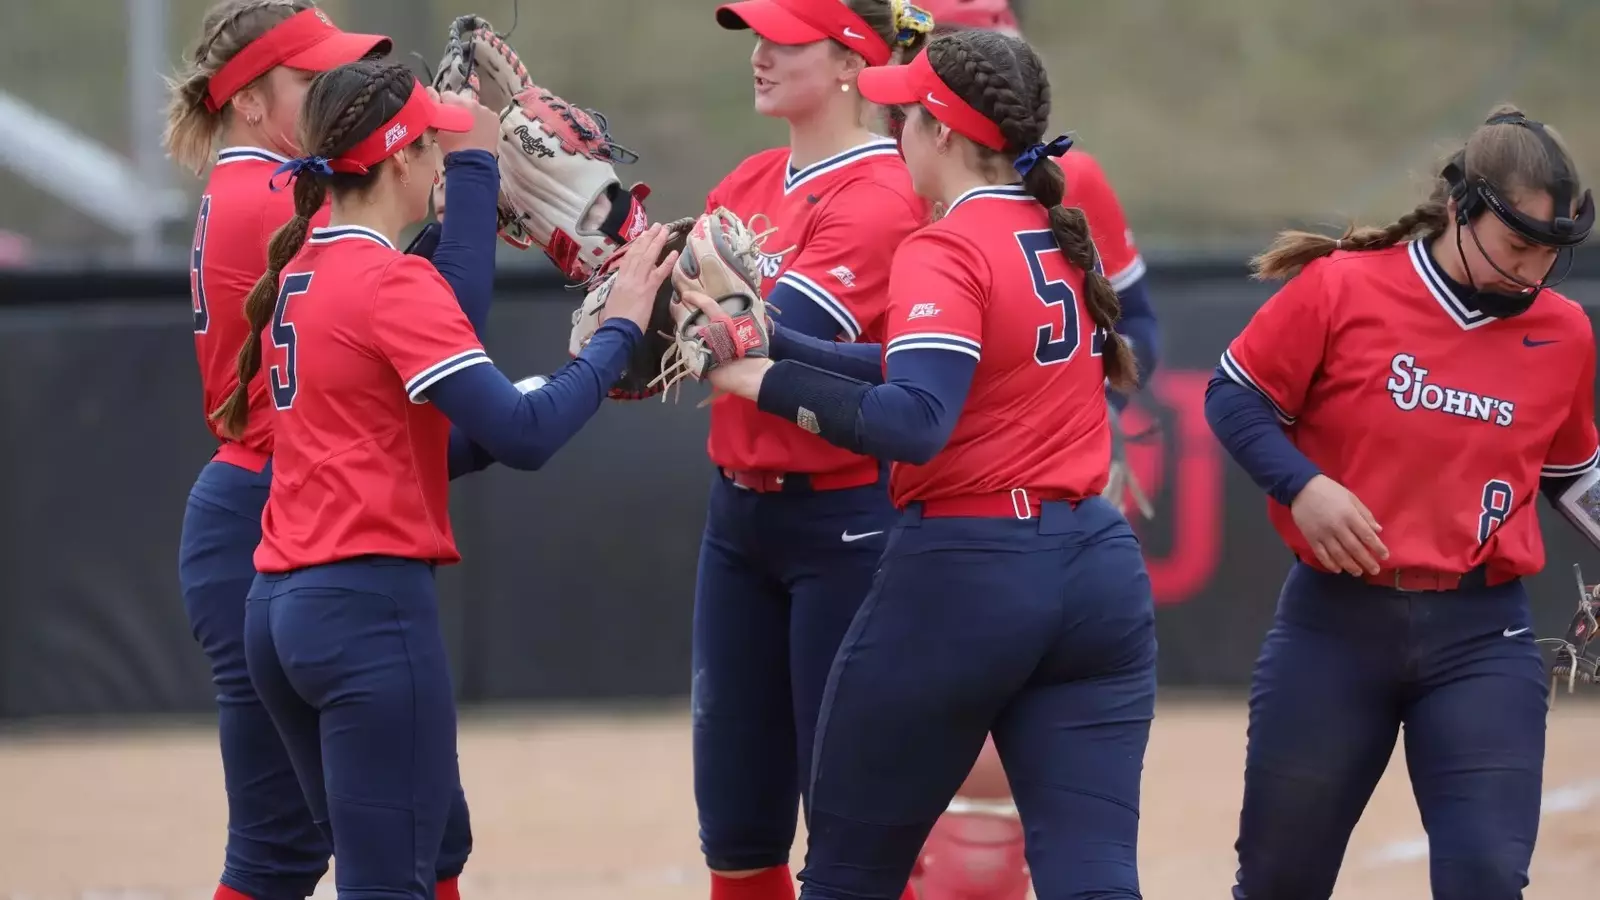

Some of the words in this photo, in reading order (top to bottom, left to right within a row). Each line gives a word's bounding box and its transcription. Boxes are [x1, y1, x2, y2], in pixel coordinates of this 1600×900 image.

[385, 122, 401, 139] BIG
[386, 124, 408, 149] EAST
[513, 124, 556, 159] Rawlings
[908, 307, 943, 318] EAST
[270, 271, 315, 411] 5
[1391, 380, 1515, 427] JOHN'S
[1477, 478, 1514, 546] 8
